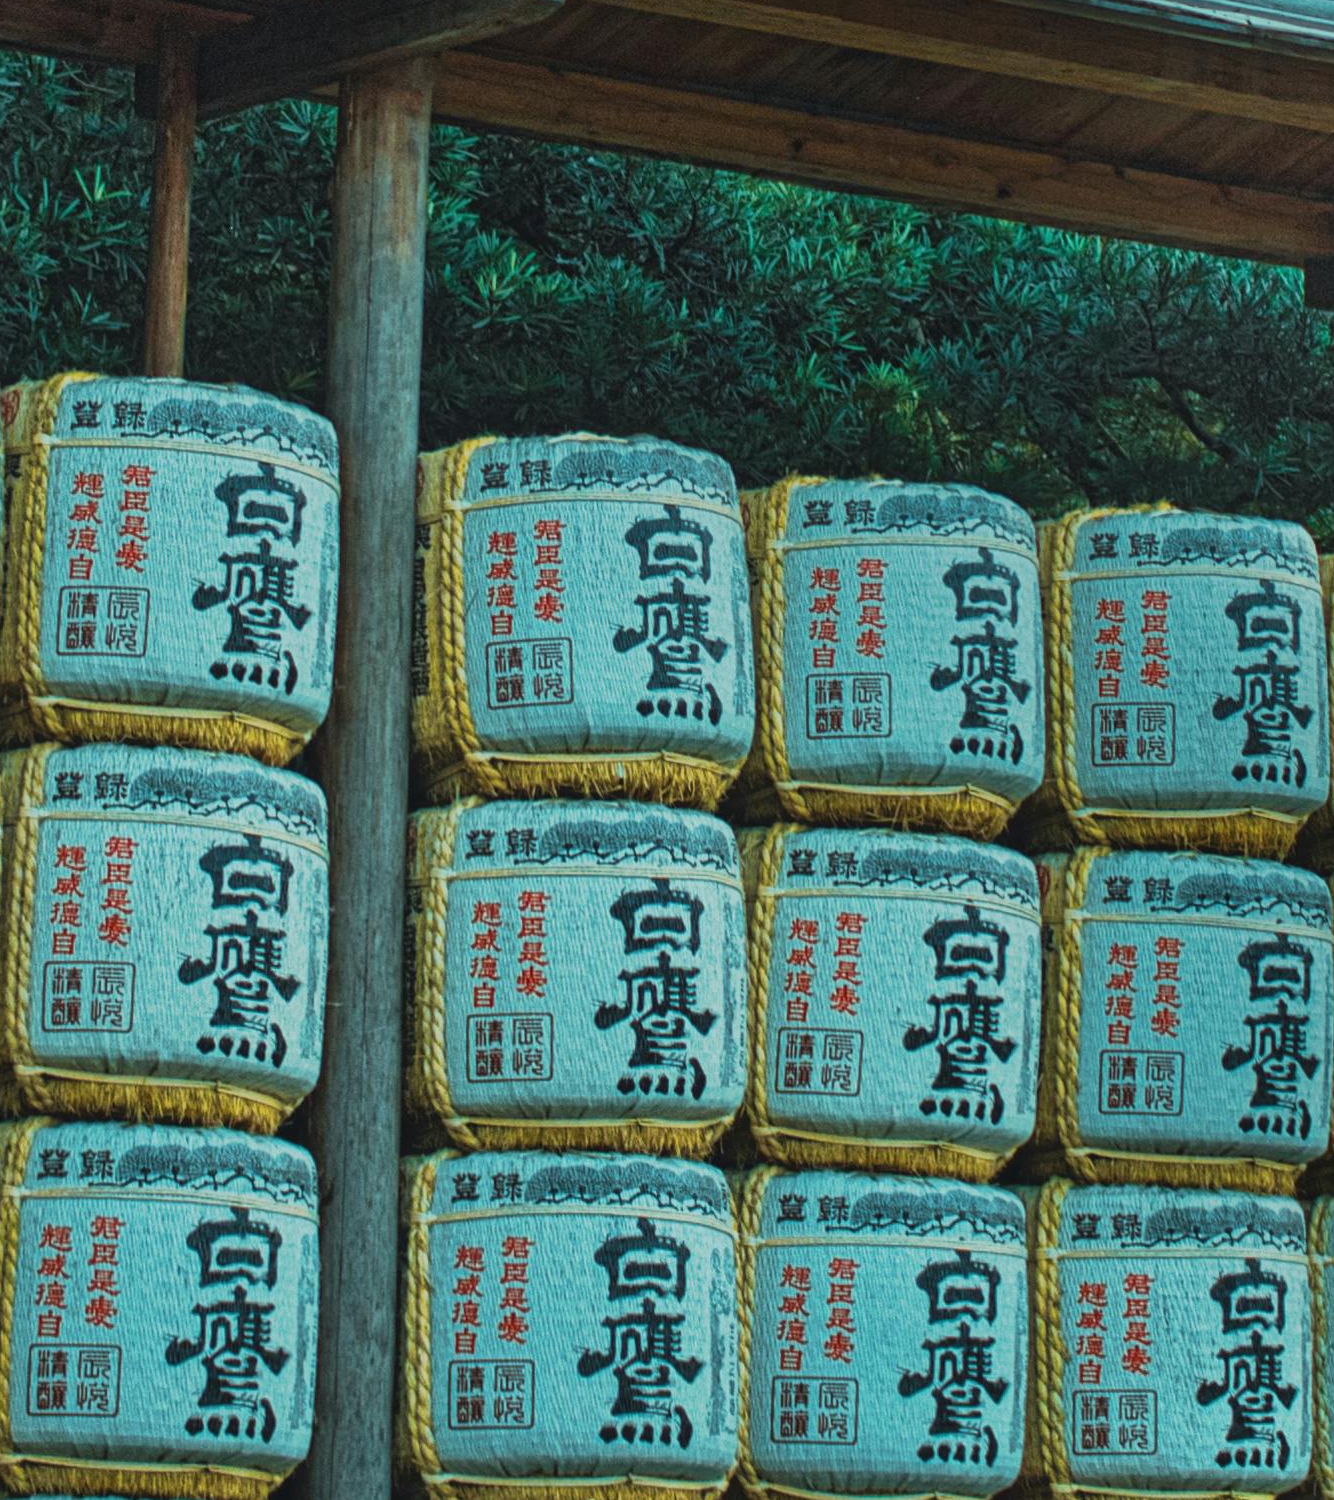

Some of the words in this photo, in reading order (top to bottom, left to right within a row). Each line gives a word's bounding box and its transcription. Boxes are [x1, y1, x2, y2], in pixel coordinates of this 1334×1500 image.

[193, 461, 311, 695] 白鷹
[614, 504, 726, 725] 白鷹
[931, 547, 1029, 764] 白鷹
[1213, 579, 1312, 788] 白鷹
[179, 833, 300, 1068] 白鷹
[594, 878, 716, 1099] 白鷹
[903, 905, 1015, 1124] 白鷹
[1222, 933, 1319, 1140] 白鷹
[165, 1206, 289, 1443] 白鷹
[578, 1217, 702, 1449] 白鷹
[898, 1250, 1008, 1467] 白鷹
[1197, 1258, 1296, 1470] 白鷹
